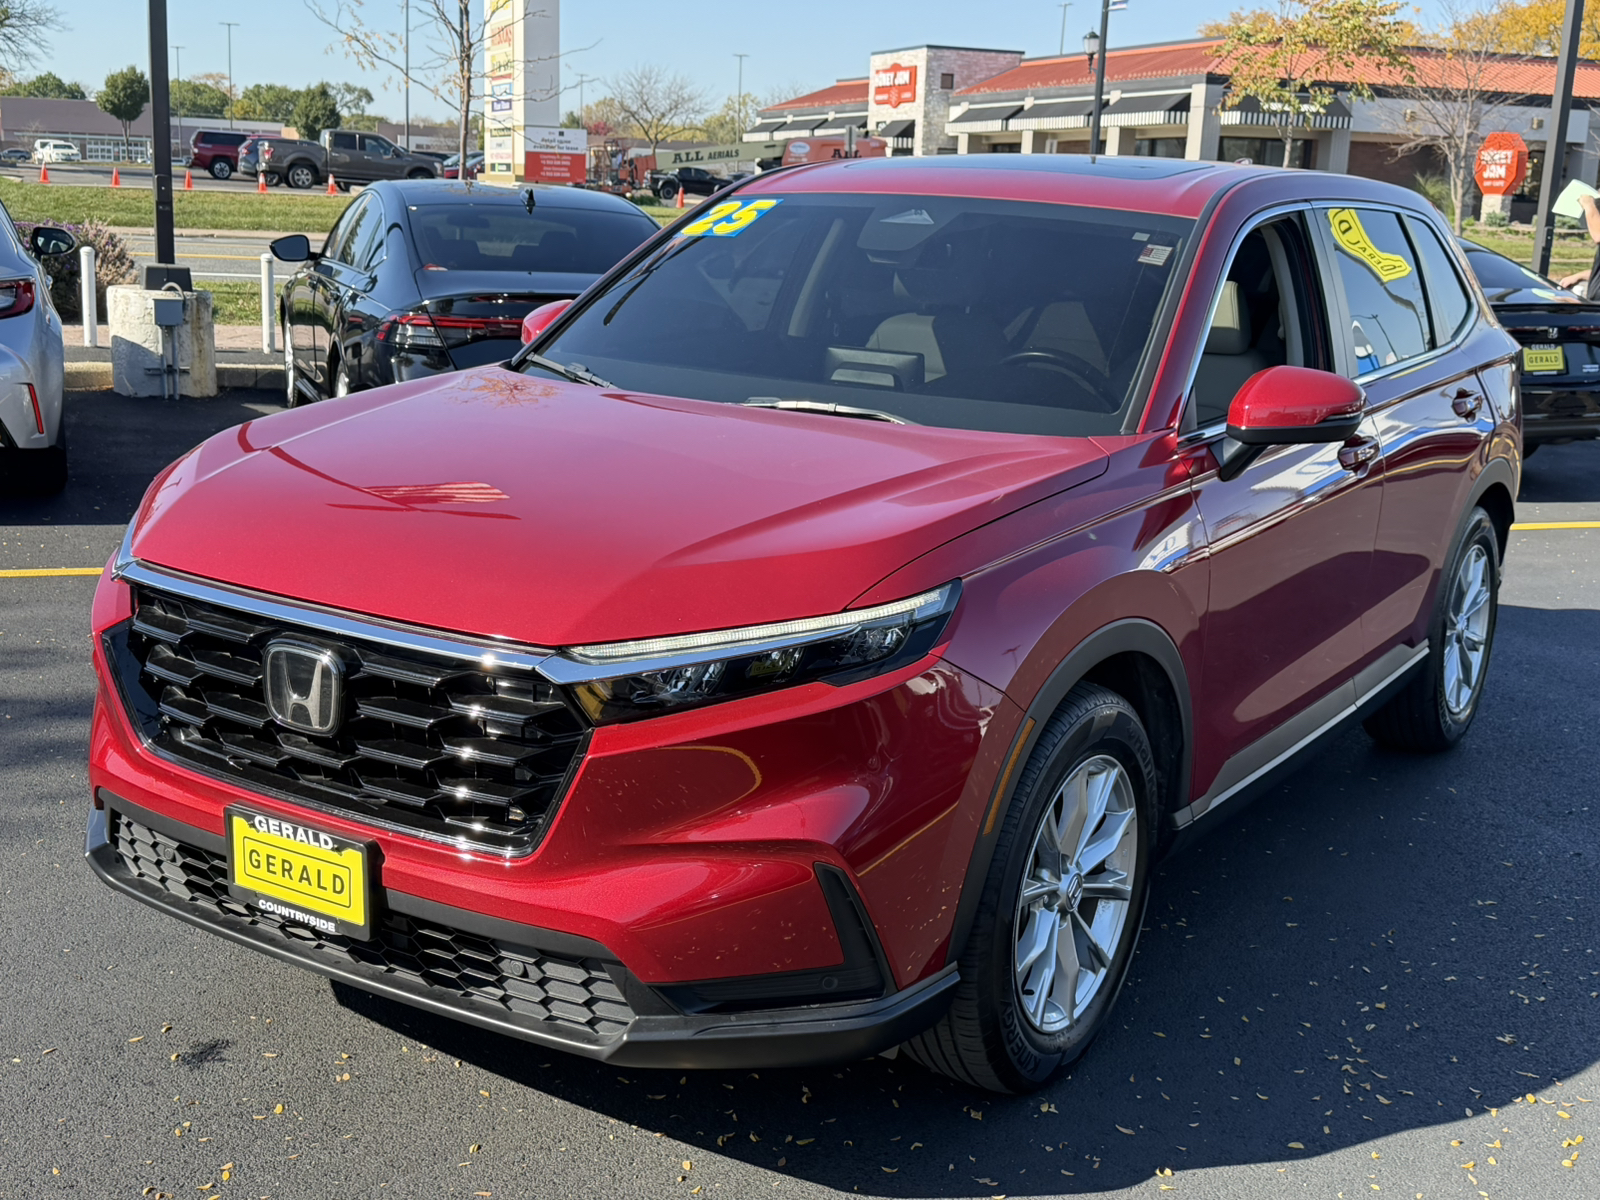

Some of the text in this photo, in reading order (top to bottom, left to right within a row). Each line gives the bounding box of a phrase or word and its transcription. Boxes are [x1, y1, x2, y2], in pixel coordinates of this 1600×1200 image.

[672, 149, 739, 164] ALL AERIALS
[1483, 164, 1507, 179] JAM
[681, 199, 777, 235] 25
[1528, 355, 1559, 364] GERALD
[254, 815, 334, 850] GERALD
[249, 849, 345, 895] GERALD
[258, 899, 336, 932] COUNTRYSIDE
